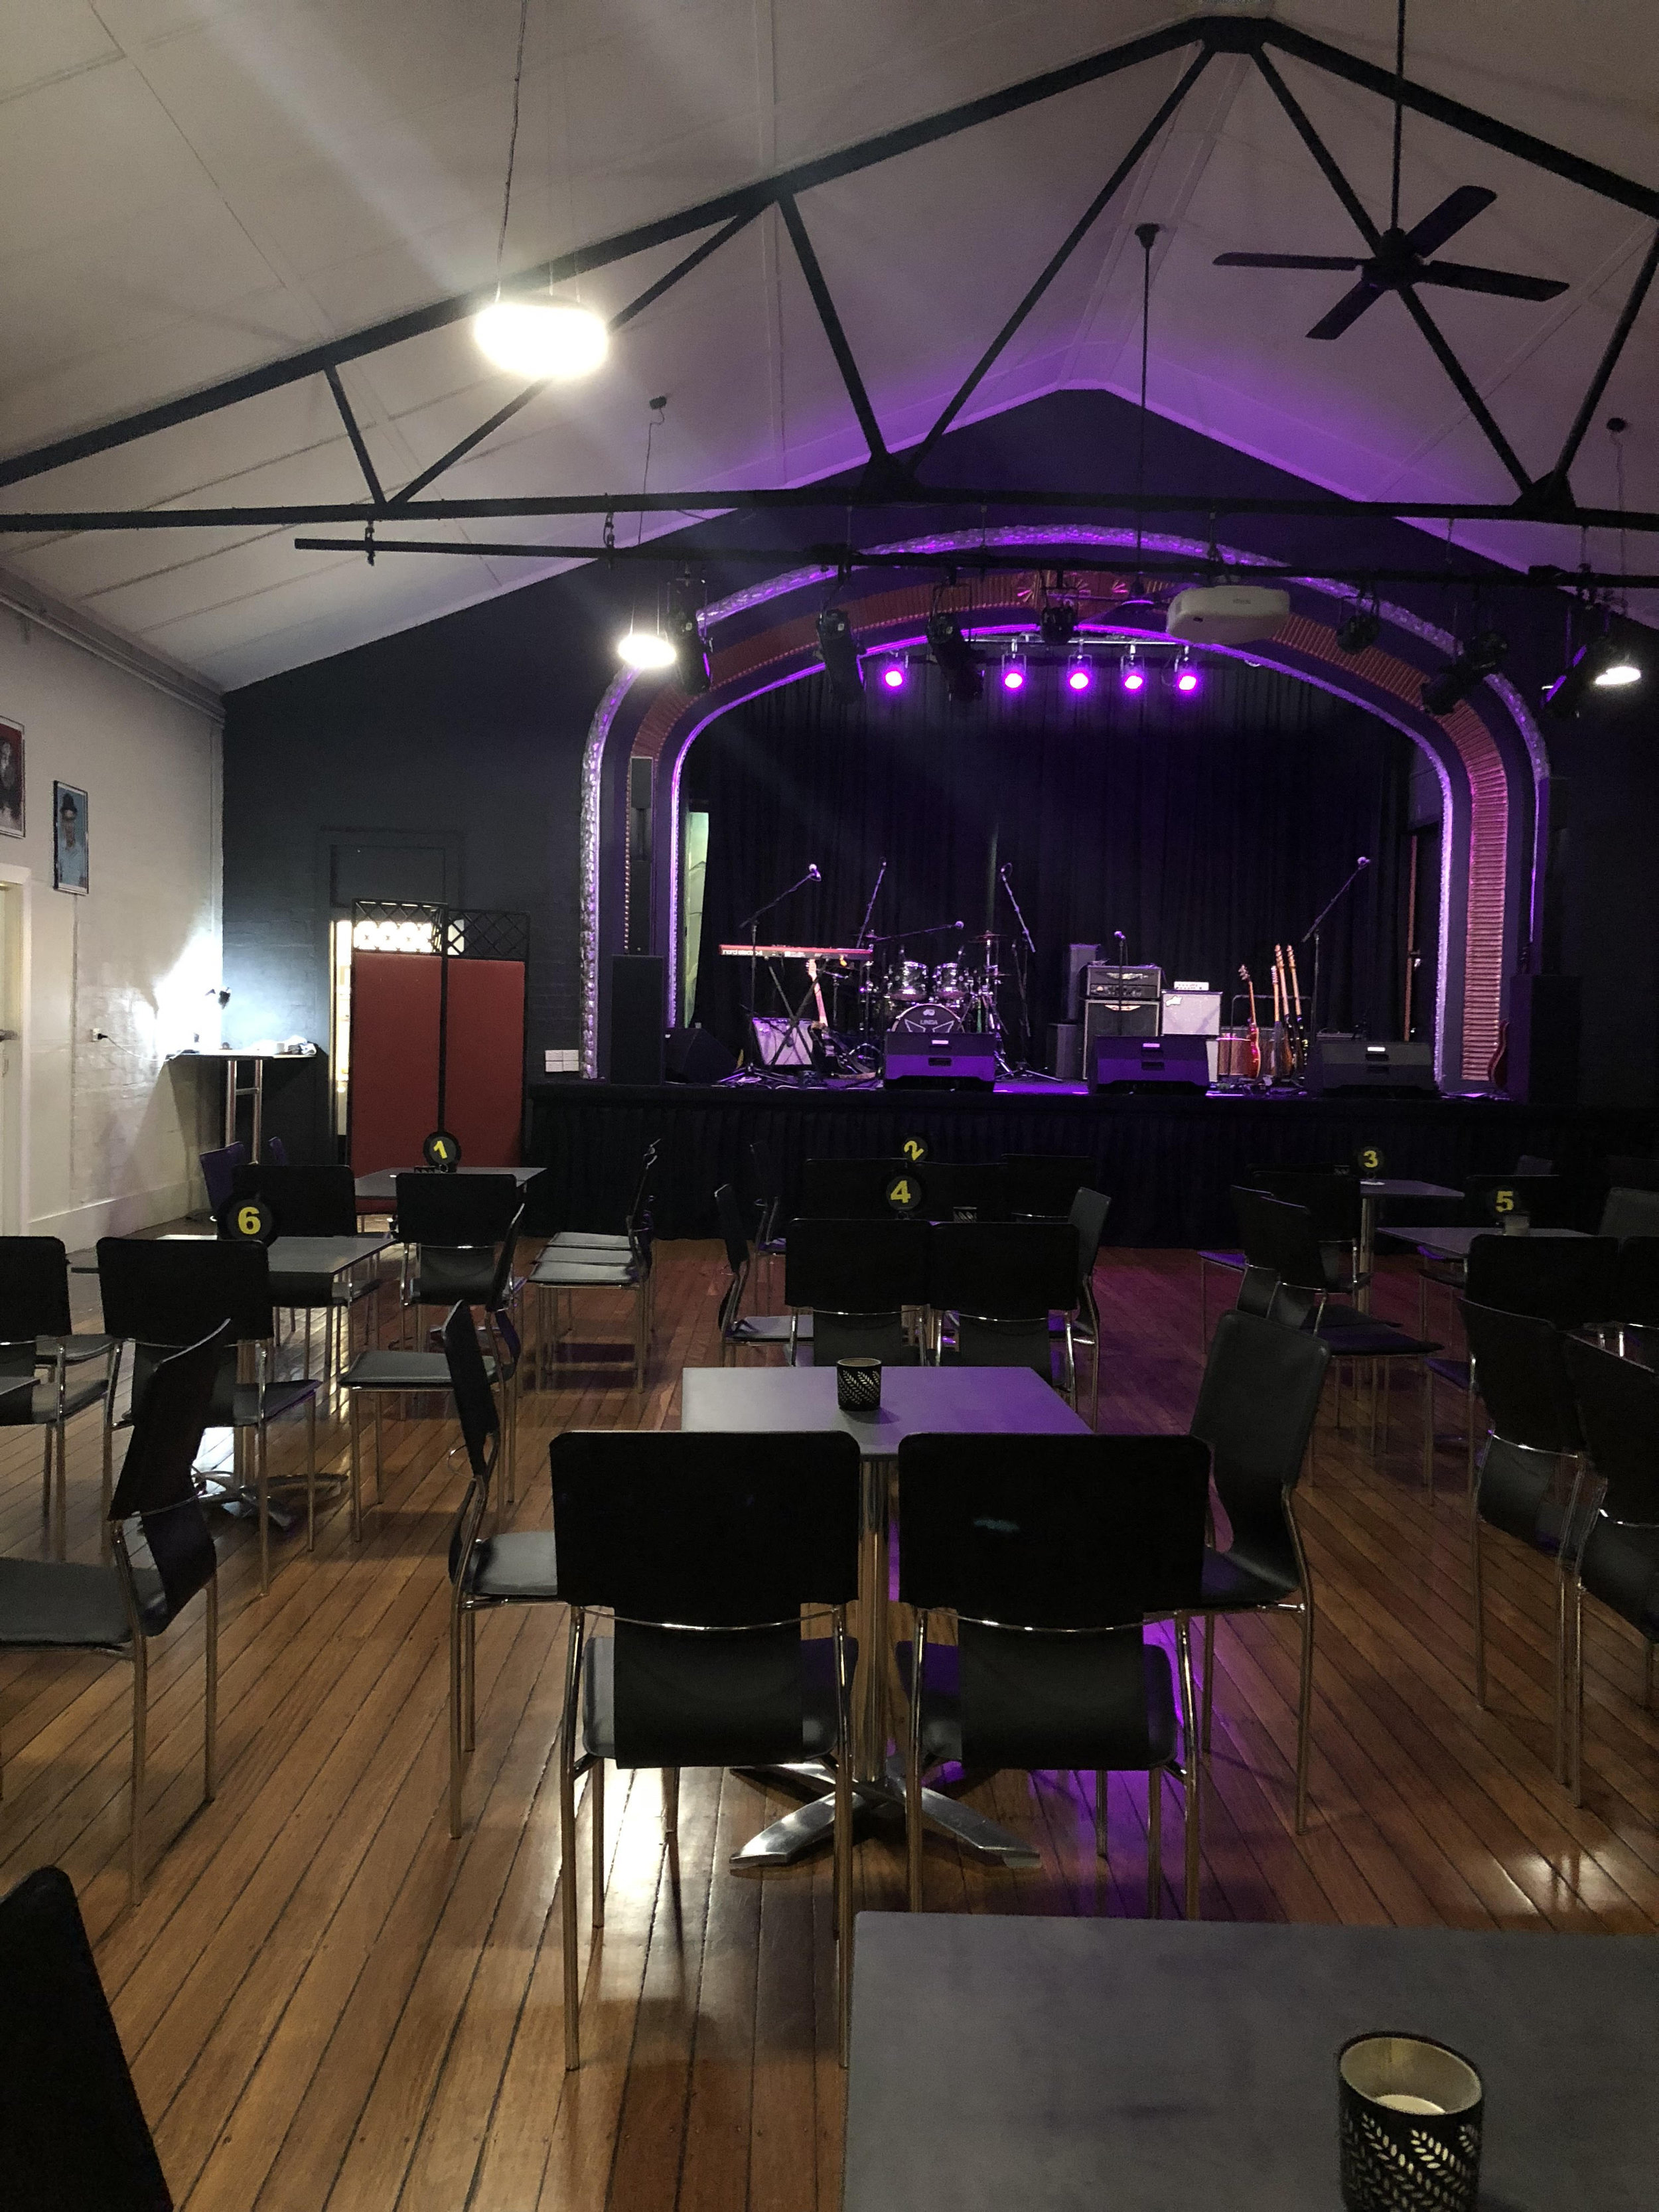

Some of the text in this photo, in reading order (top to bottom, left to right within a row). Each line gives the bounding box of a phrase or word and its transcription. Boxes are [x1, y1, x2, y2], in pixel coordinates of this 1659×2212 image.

[433, 1140, 448, 1159] 1
[904, 1140, 924, 1161] 2
[1364, 1150, 1378, 1168] 3
[891, 1180, 911, 1203] 4
[1495, 1191, 1514, 1213] 5
[238, 1207, 261, 1234] 6
